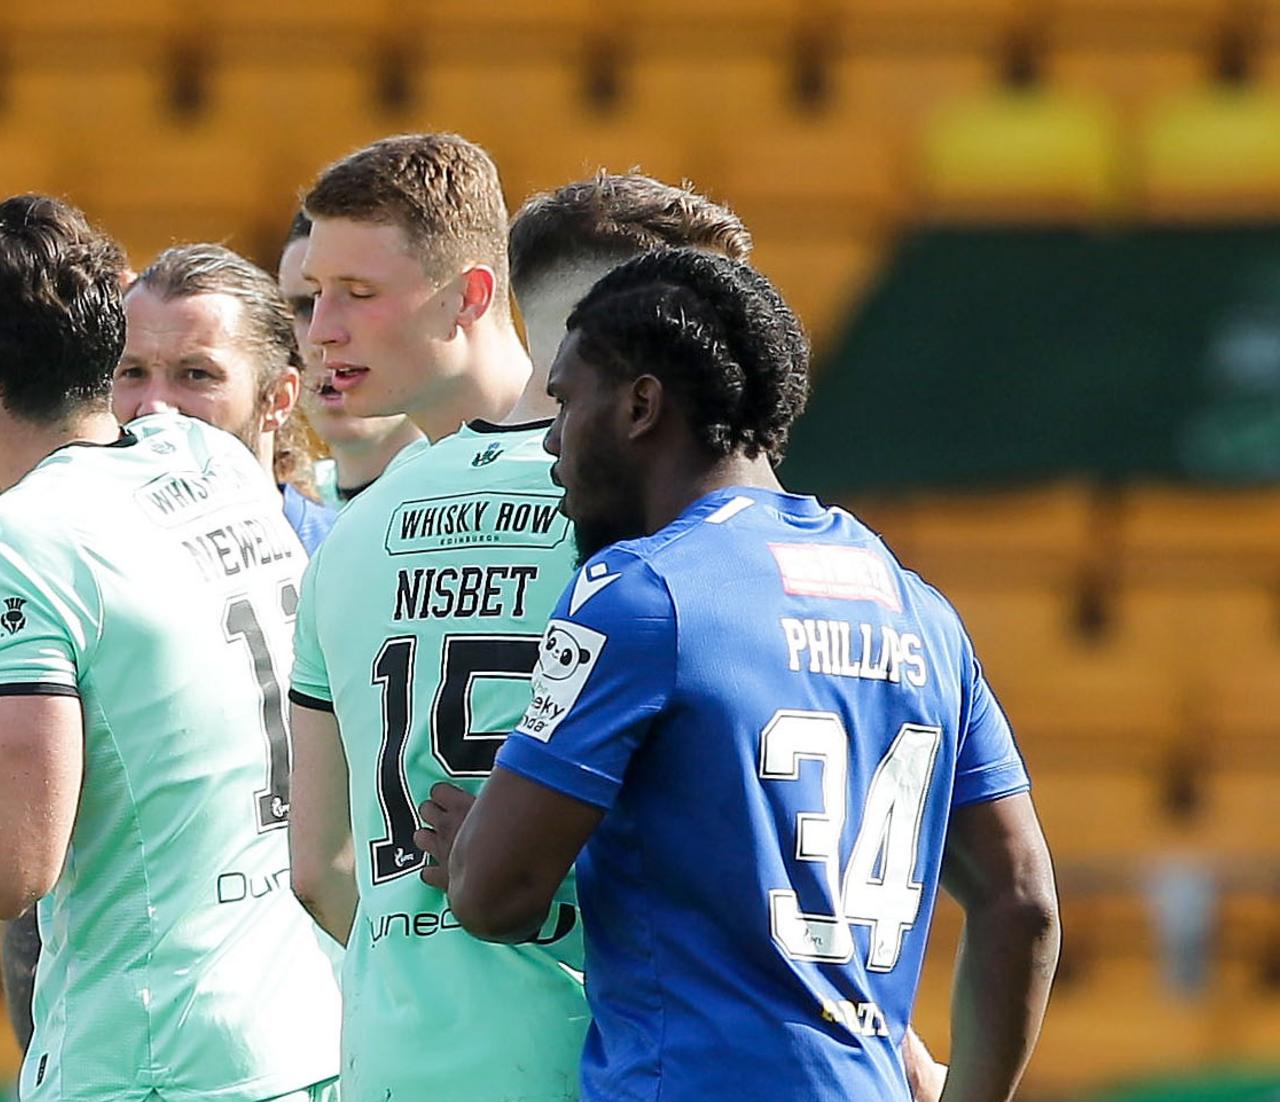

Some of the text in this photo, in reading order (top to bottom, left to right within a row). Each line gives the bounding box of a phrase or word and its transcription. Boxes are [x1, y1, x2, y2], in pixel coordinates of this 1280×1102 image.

[400, 502, 560, 540] WHISKY ROW
[440, 535, 500, 546] EDINBURGH
[393, 566, 538, 621] NISBET
[758, 709, 942, 974] 34
